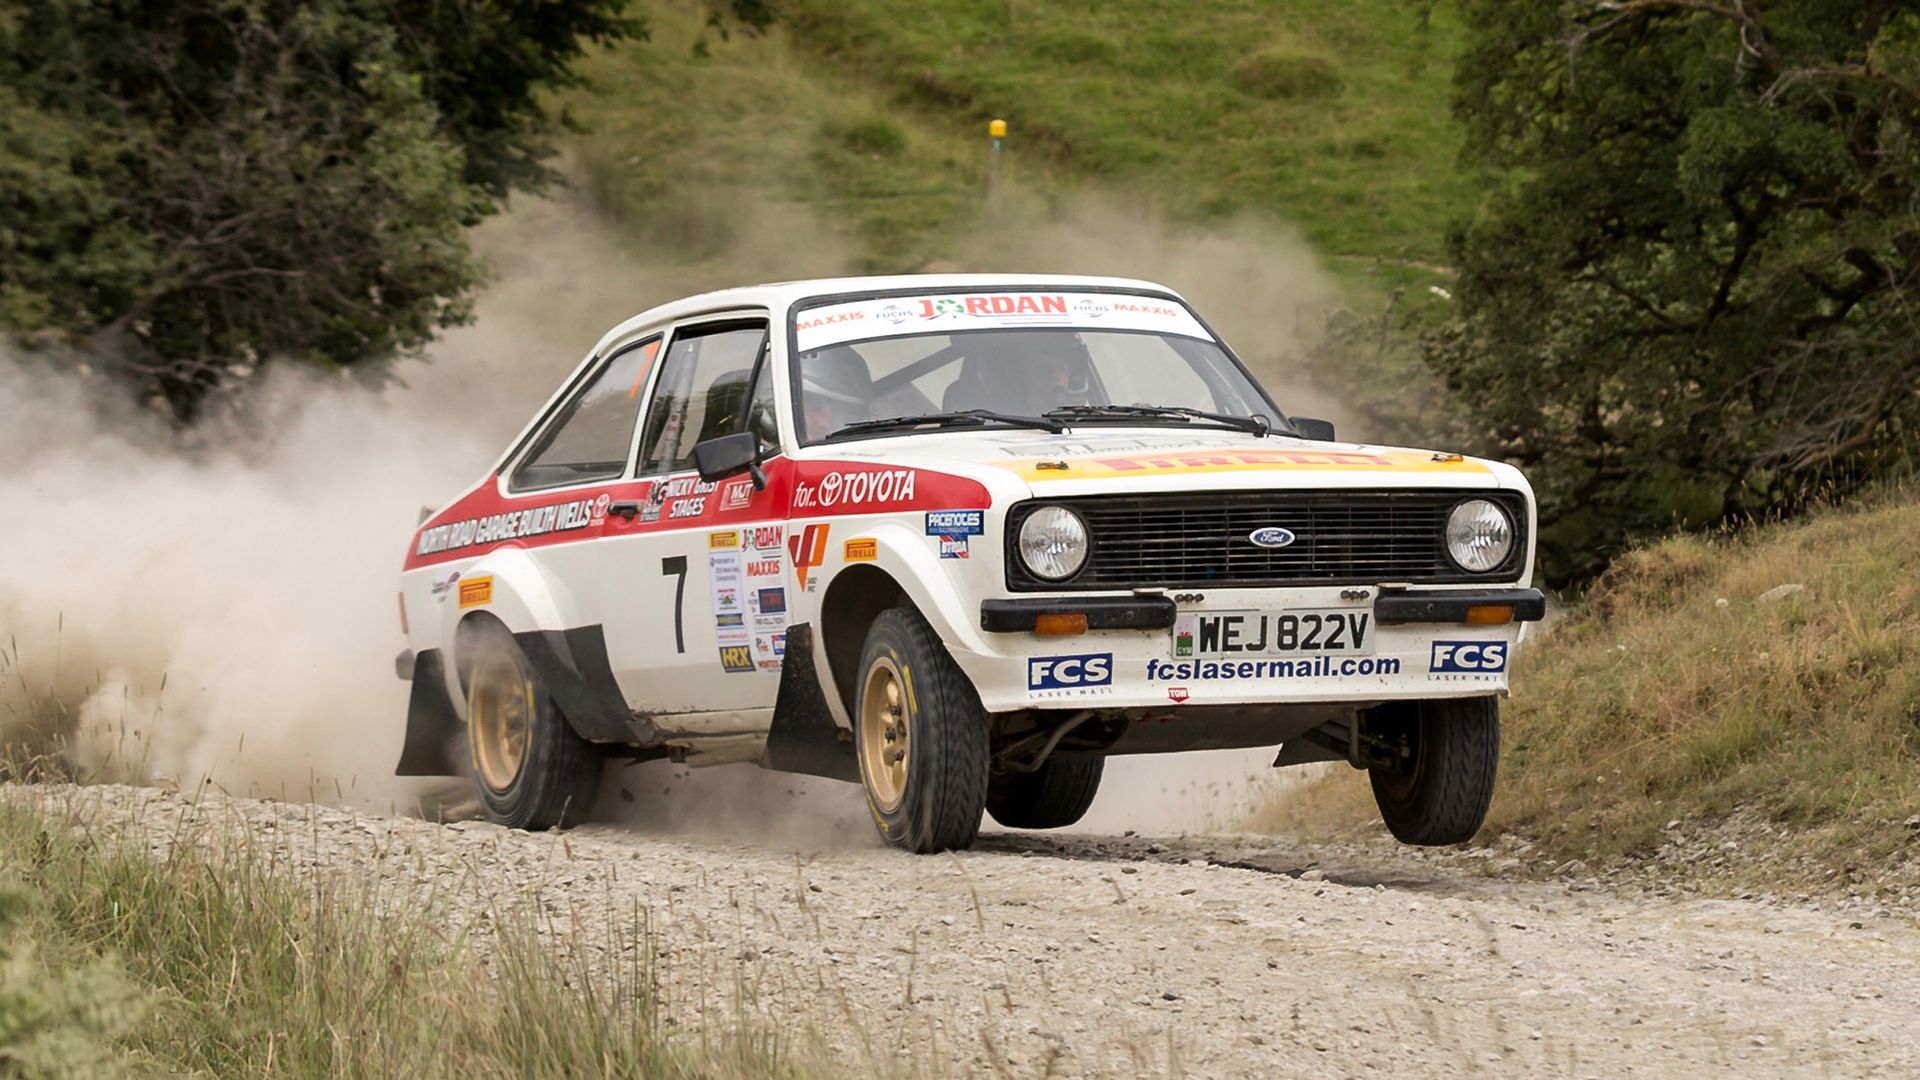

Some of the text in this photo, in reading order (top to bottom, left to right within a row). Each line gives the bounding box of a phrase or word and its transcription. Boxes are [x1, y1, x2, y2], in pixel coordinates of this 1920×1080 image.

[875, 310, 914, 319] FUCHS
[1073, 304, 1110, 313] FUCHS
[1114, 303, 1176, 317] MAXXIS
[796, 311, 864, 331] MAXXIS
[731, 483, 754, 500] MJT
[842, 470, 916, 504] TOYOTA
[668, 497, 706, 518] STAGES
[475, 510, 523, 544] GARAGE
[517, 504, 560, 538] BUILTH
[555, 498, 594, 532] WELLS
[928, 512, 980, 527] PACENOTES
[846, 542, 875, 559] PIRELLI
[747, 560, 780, 577] MAXXIS
[661, 555, 688, 653] 7
[1199, 612, 1369, 653] WEJ 822V
[721, 646, 751, 668] HRX
[1433, 645, 1504, 669] FCS
[1031, 658, 1110, 686] FCS
[1147, 656, 1401, 681] fcslasermail.com
[1029, 687, 1113, 699] LASER MAIL
[1169, 689, 1188, 699] TOW
